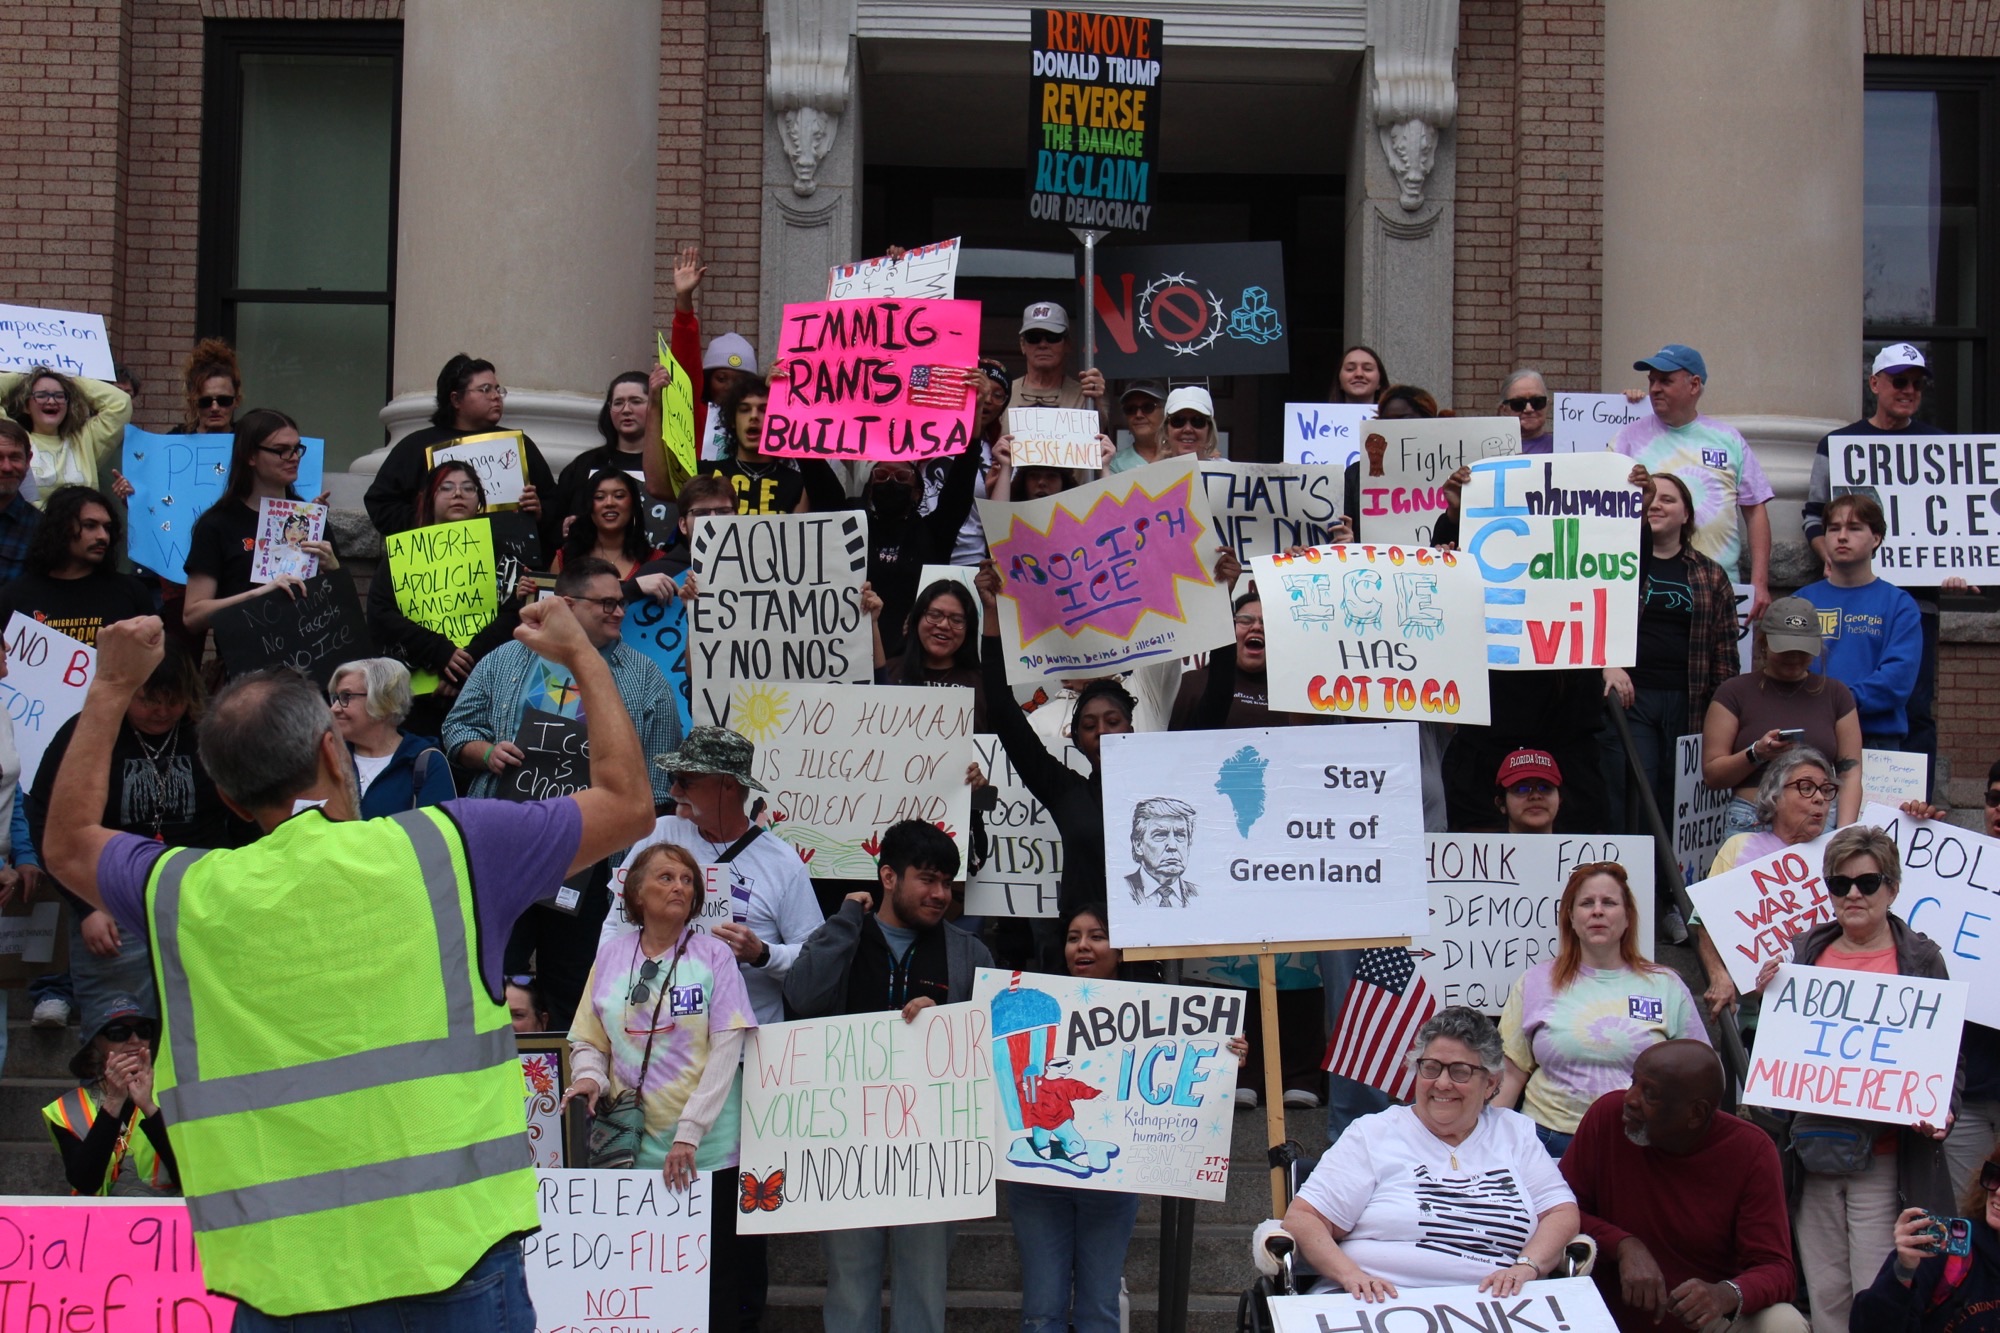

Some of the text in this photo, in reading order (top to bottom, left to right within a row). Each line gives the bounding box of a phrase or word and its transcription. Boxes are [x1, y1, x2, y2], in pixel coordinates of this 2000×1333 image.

[1047, 10, 1150, 58] REMOVE
[1033, 50, 1160, 86] DONALD TRUMP
[1042, 82, 1146, 131] REVERSE
[1042, 123, 1143, 157] THE DAMAGE
[1035, 150, 1149, 202] RECLAIM
[1030, 193, 1151, 231] OUR DEMOCRACY
[23, 341, 57, 351] over
[788, 357, 902, 406] RANTS
[1010, 409, 1045, 433] ICE
[1297, 410, 1349, 441] We're
[1560, 398, 1584, 421] for
[764, 414, 881, 454] BUILT
[1030, 431, 1067, 441] under
[1400, 437, 1466, 482] Fight
[1702, 450, 1727, 468] P4P
[1201, 471, 1335, 522] THAT'S
[1466, 460, 1643, 519] Inhumane
[388, 538, 404, 559] LA
[410, 526, 480, 565] MIGRA
[709, 518, 833, 586] AQUI
[1009, 507, 1186, 586] ABOLISH
[1468, 517, 1638, 583] Callous
[1871, 545, 2000, 569] REFERRE
[393, 559, 488, 600] LA POLICIA
[1055, 558, 1138, 612] ICE
[1281, 569, 1444, 628] ICE
[89, 617, 103, 625] ARE
[421, 588, 484, 619] MISMA
[693, 585, 861, 636] ESTAMOS
[1844, 614, 1883, 626] Georgia
[9, 625, 48, 667] NO
[1484, 587, 1608, 667] Evil
[699, 637, 849, 680] Y NO NOS
[1045, 653, 1081, 665] human
[1122, 645, 1130, 655] is
[1338, 639, 1417, 671] HAS
[1308, 675, 1461, 715] GOT TO GO
[782, 698, 974, 741] NO HUMAN
[554, 757, 573, 779] is
[760, 748, 949, 785] IS ILLEGAL ON
[1323, 764, 1386, 794] Stay
[1510, 753, 1551, 768] FLORIDA STATE
[777, 791, 947, 827] STOLEN LAND
[1286, 815, 1379, 840] out of
[1679, 812, 1727, 854] FOREIG
[1230, 858, 1381, 883] Greenland
[1426, 841, 1516, 880] HONK
[1750, 852, 1809, 897] NO
[1734, 889, 1796, 930] WAR
[672, 988, 703, 1012] P4P
[1629, 998, 1662, 1019] P4P
[1773, 976, 1942, 1030] ABOLISH
[1066, 995, 1241, 1057] ABOLISH
[1803, 1020, 1904, 1065] ICE
[755, 1009, 991, 1088] WE RAISE OUR
[1116, 1040, 1220, 1107] ICE
[1745, 1056, 1943, 1118] MURDERERS
[746, 1079, 989, 1140] VOICES FOR THE
[1124, 1104, 1198, 1141] Kidnapping
[1126, 1144, 1205, 1169] ISN'T
[1132, 1130, 1176, 1144] humans
[784, 1139, 994, 1203] UNDOCUMENTED
[1195, 1170, 1225, 1184] EVIL
[1203, 1156, 1230, 1171] IT'S
[538, 1177, 702, 1217] RELEASE
[522, 1230, 708, 1274] PEDO-FILES
[156, 1297, 213, 1333] in
[586, 1286, 653, 1320] NOT
